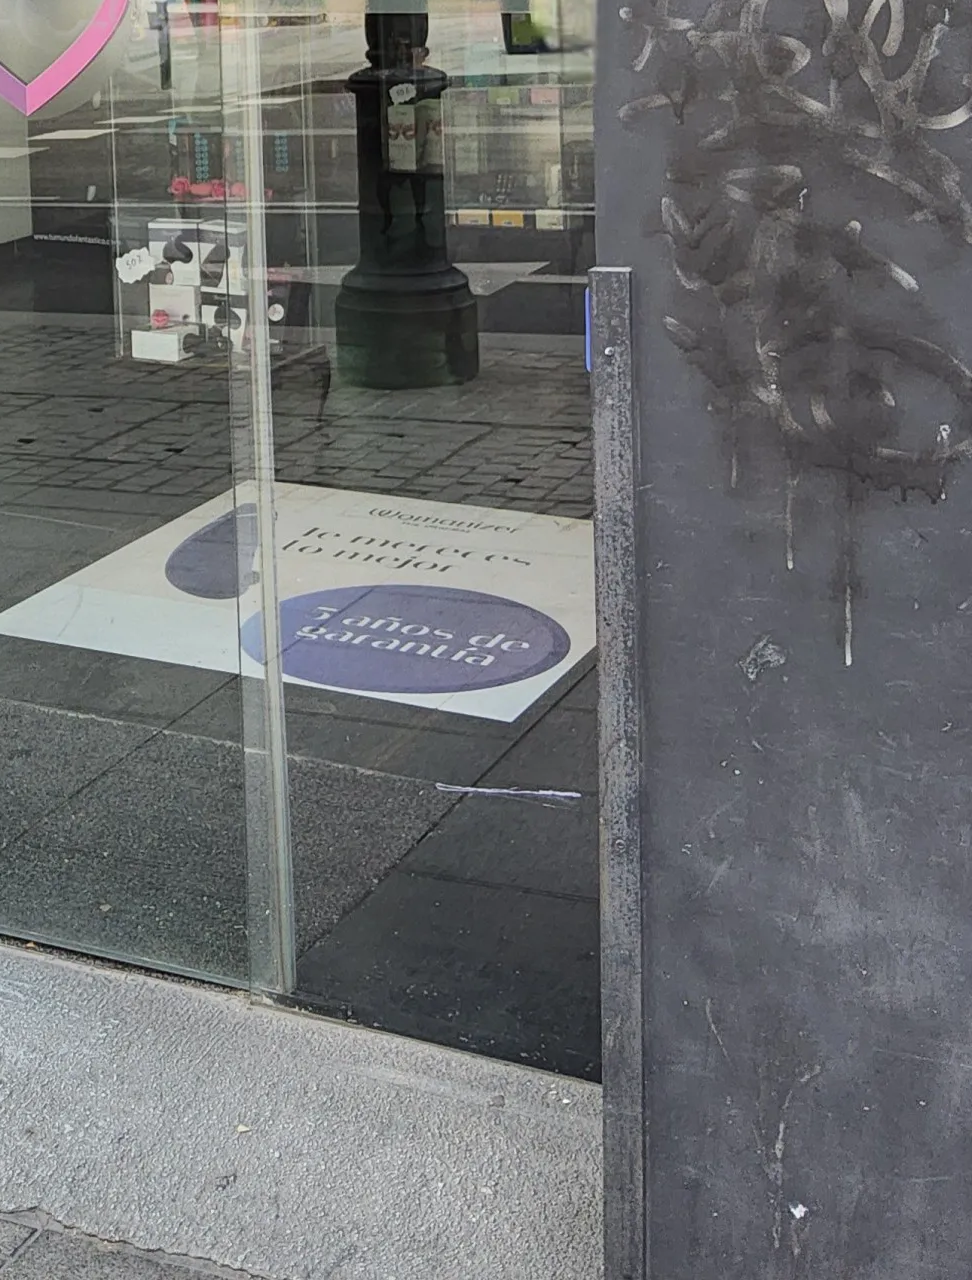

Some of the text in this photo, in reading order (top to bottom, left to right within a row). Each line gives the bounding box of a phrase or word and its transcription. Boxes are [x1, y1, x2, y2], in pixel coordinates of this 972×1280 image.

[282, 540, 460, 572] lo mejor
[350, 535, 531, 566] mereces
[295, 625, 496, 667] garantía
[341, 616, 456, 640] años
[468, 633, 530, 652] de
